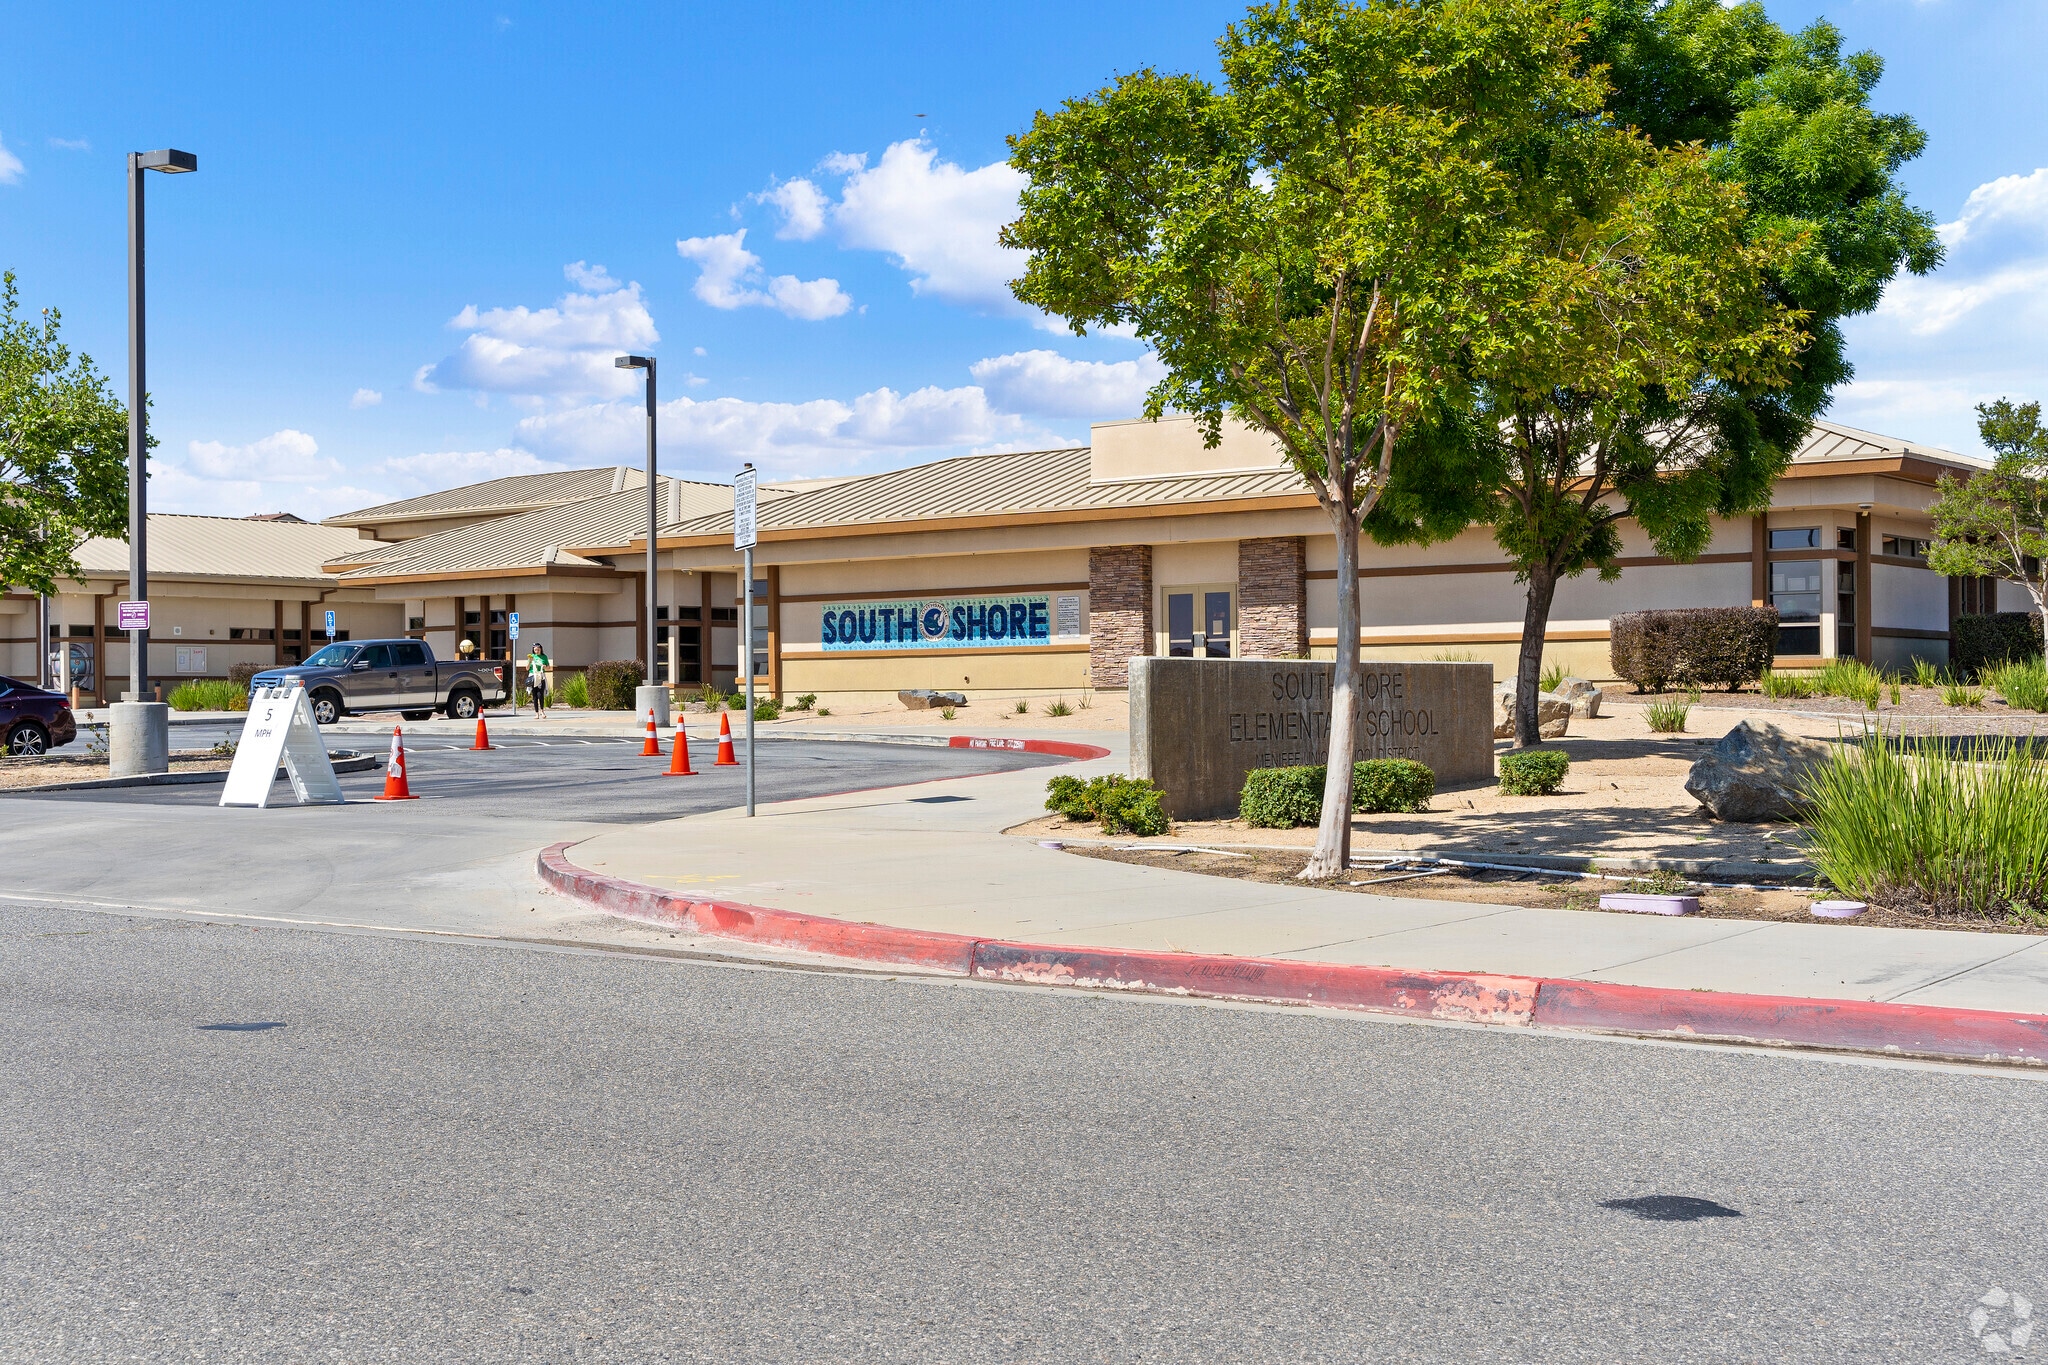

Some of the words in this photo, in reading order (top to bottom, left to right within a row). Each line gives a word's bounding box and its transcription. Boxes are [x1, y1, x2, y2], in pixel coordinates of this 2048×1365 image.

[823, 608, 917, 644] SOUTH
[952, 602, 1047, 641] SHORE
[1358, 672, 1403, 700] HORE
[265, 708, 273, 721] 5
[1366, 709, 1439, 737] SCHOOL
[254, 729, 272, 738] MPH
[1255, 751, 1301, 768] MENIFEE
[1304, 750, 1328, 766] UNIO
[1378, 746, 1420, 760] DISTRICT
